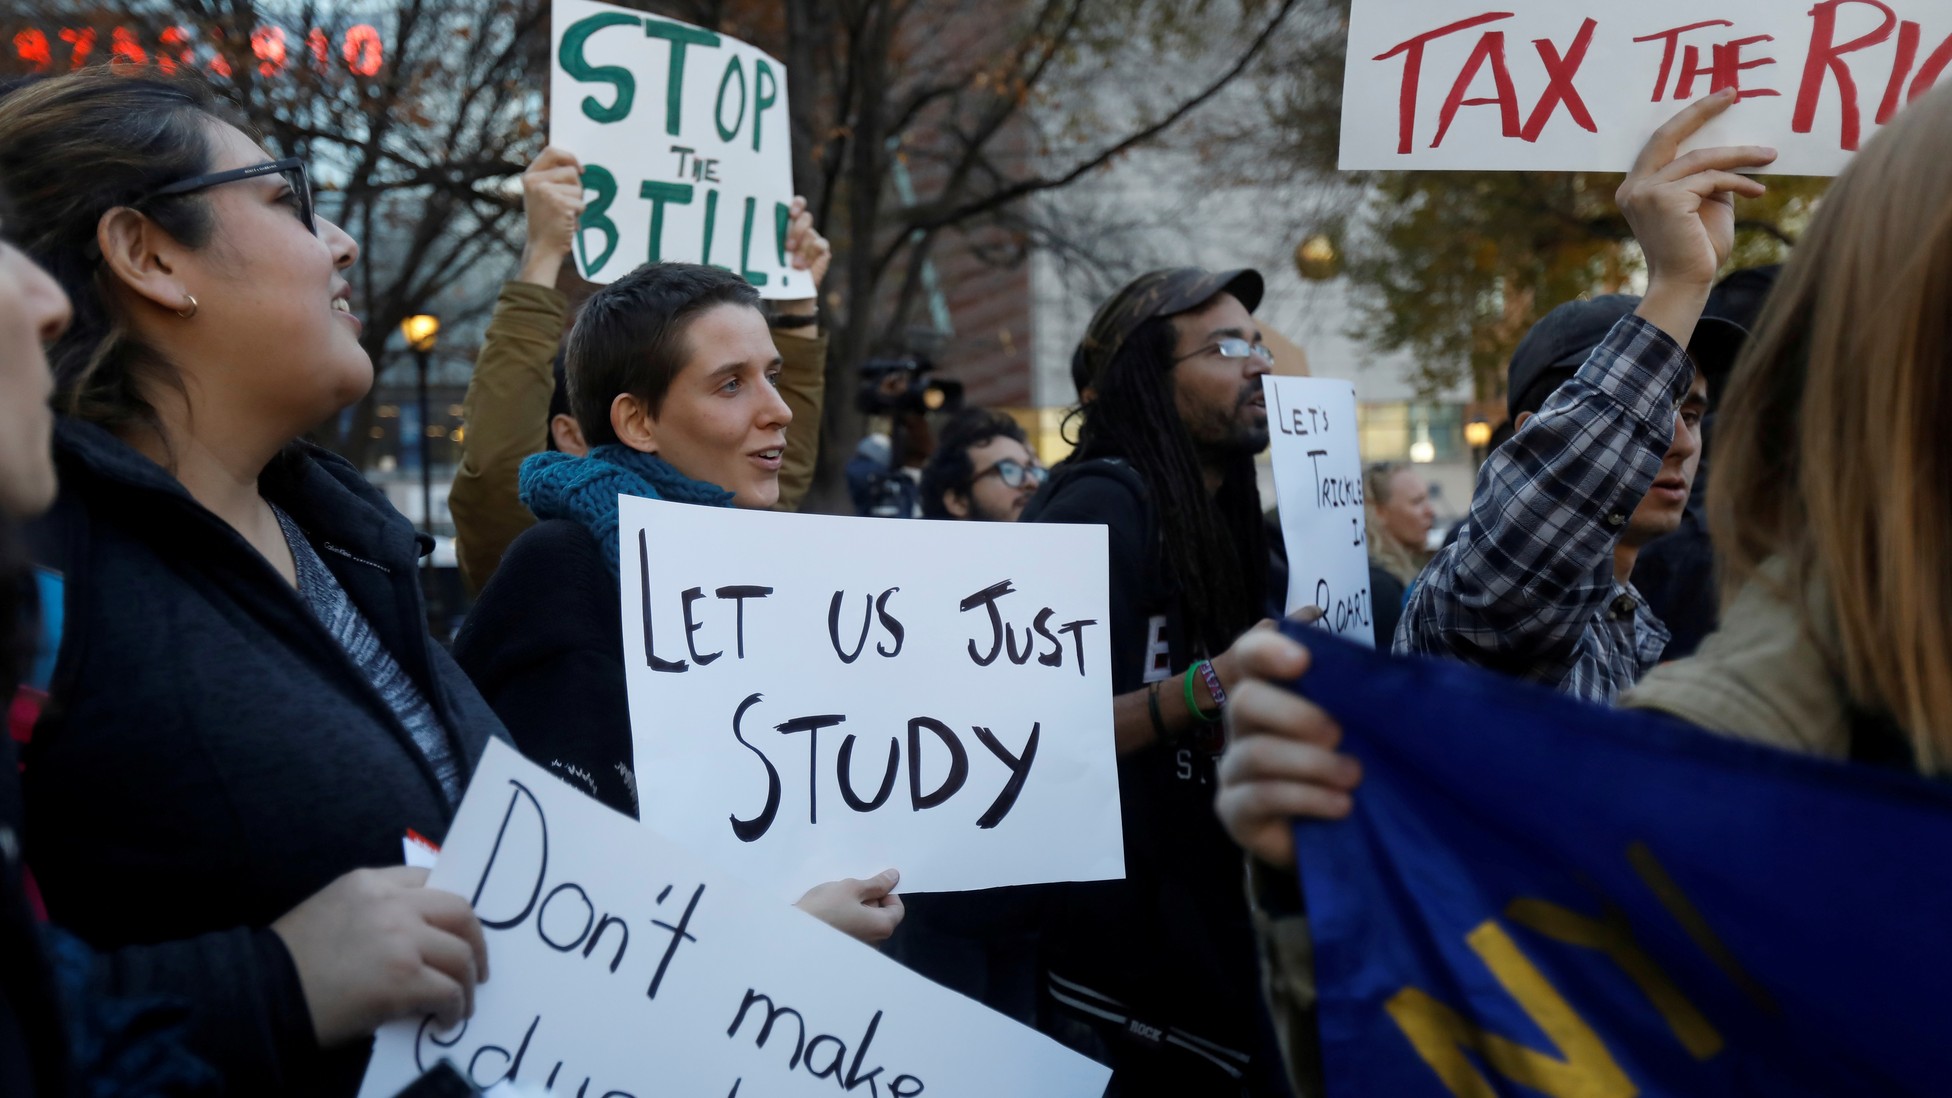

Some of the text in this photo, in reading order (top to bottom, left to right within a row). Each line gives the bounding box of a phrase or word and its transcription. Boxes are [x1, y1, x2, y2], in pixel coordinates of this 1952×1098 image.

[558, 11, 777, 152] STOP
[1372, 12, 1598, 155] TAX
[1633, 20, 1782, 104] THE
[573, 163, 791, 287] BILL!
[669, 145, 721, 184] THE
[1306, 449, 1364, 509] TRICKLE
[638, 528, 1099, 677] LET US JUST
[729, 691, 1042, 843] STUDY
[472, 778, 706, 1001] Don't
[726, 987, 926, 1098] make
